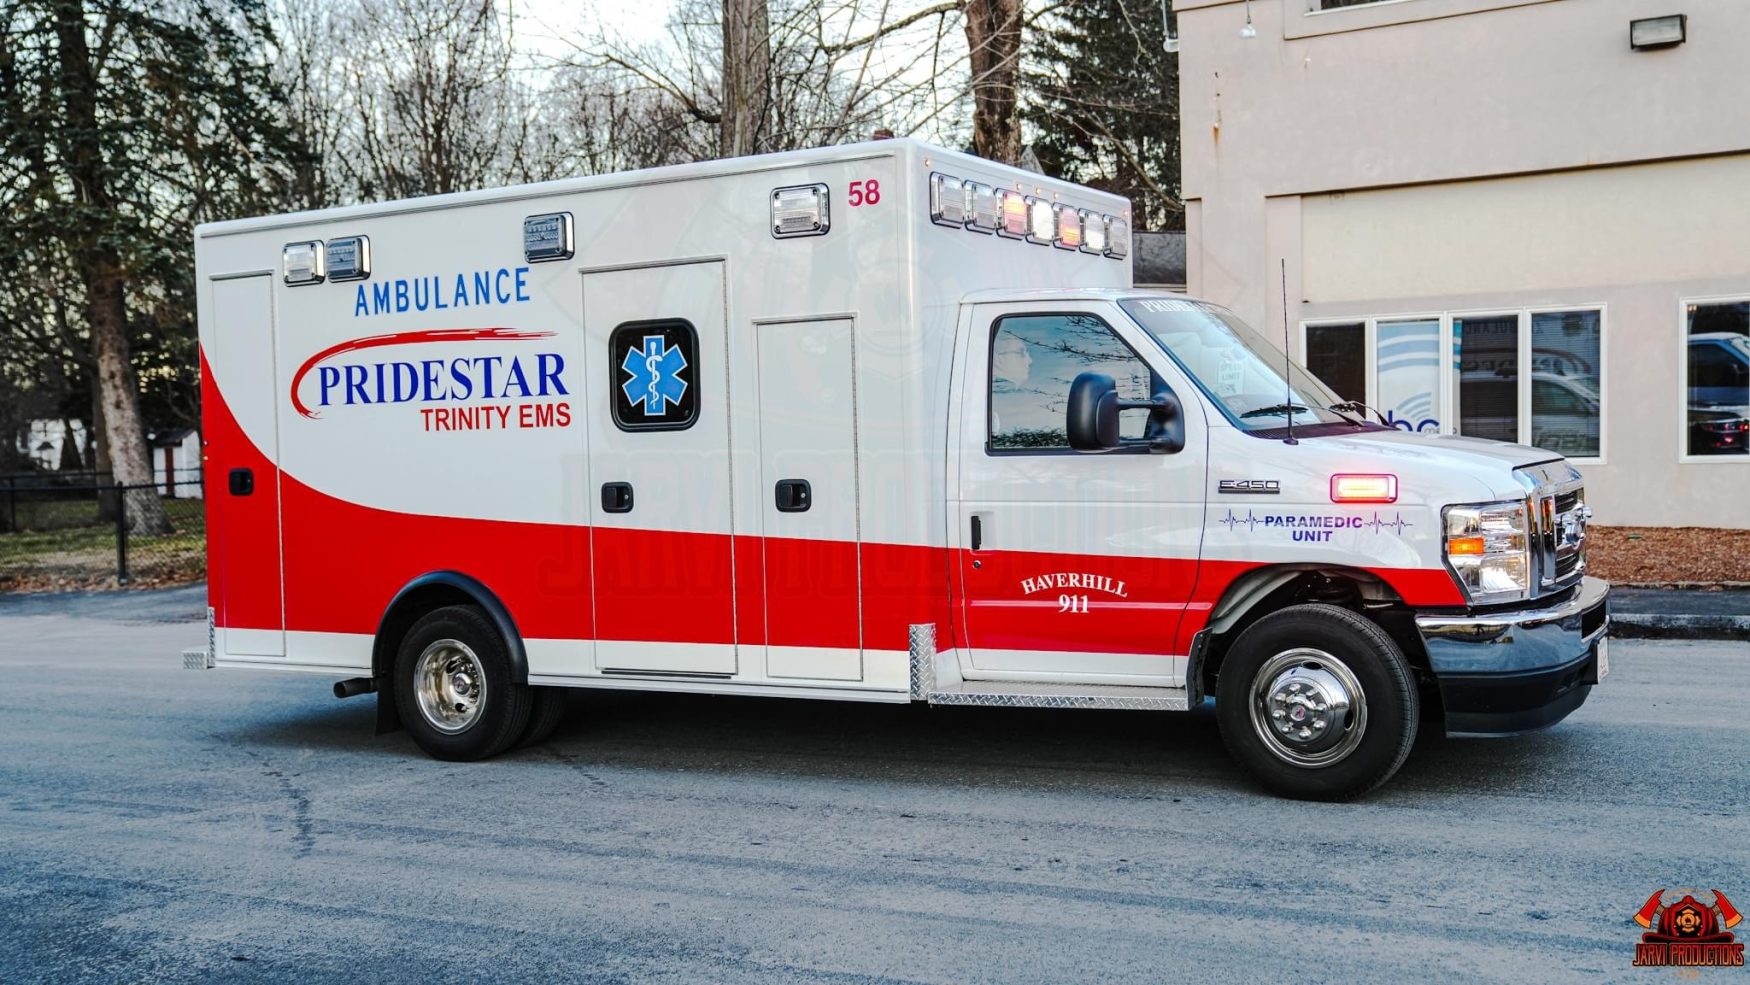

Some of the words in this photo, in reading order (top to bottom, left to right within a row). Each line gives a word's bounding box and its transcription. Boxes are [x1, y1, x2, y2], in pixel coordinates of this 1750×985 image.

[849, 179, 880, 206] 58
[355, 267, 530, 316] AMBULANCE
[318, 353, 570, 406] PRIDESTAR
[421, 405, 511, 431] TRINITY
[519, 402, 571, 429] EMS
[1264, 515, 1363, 529] PARAMEDIC
[1292, 530, 1333, 542] UNIT
[1020, 573, 1128, 598] HAVERHILL
[1058, 594, 1089, 613] 911
